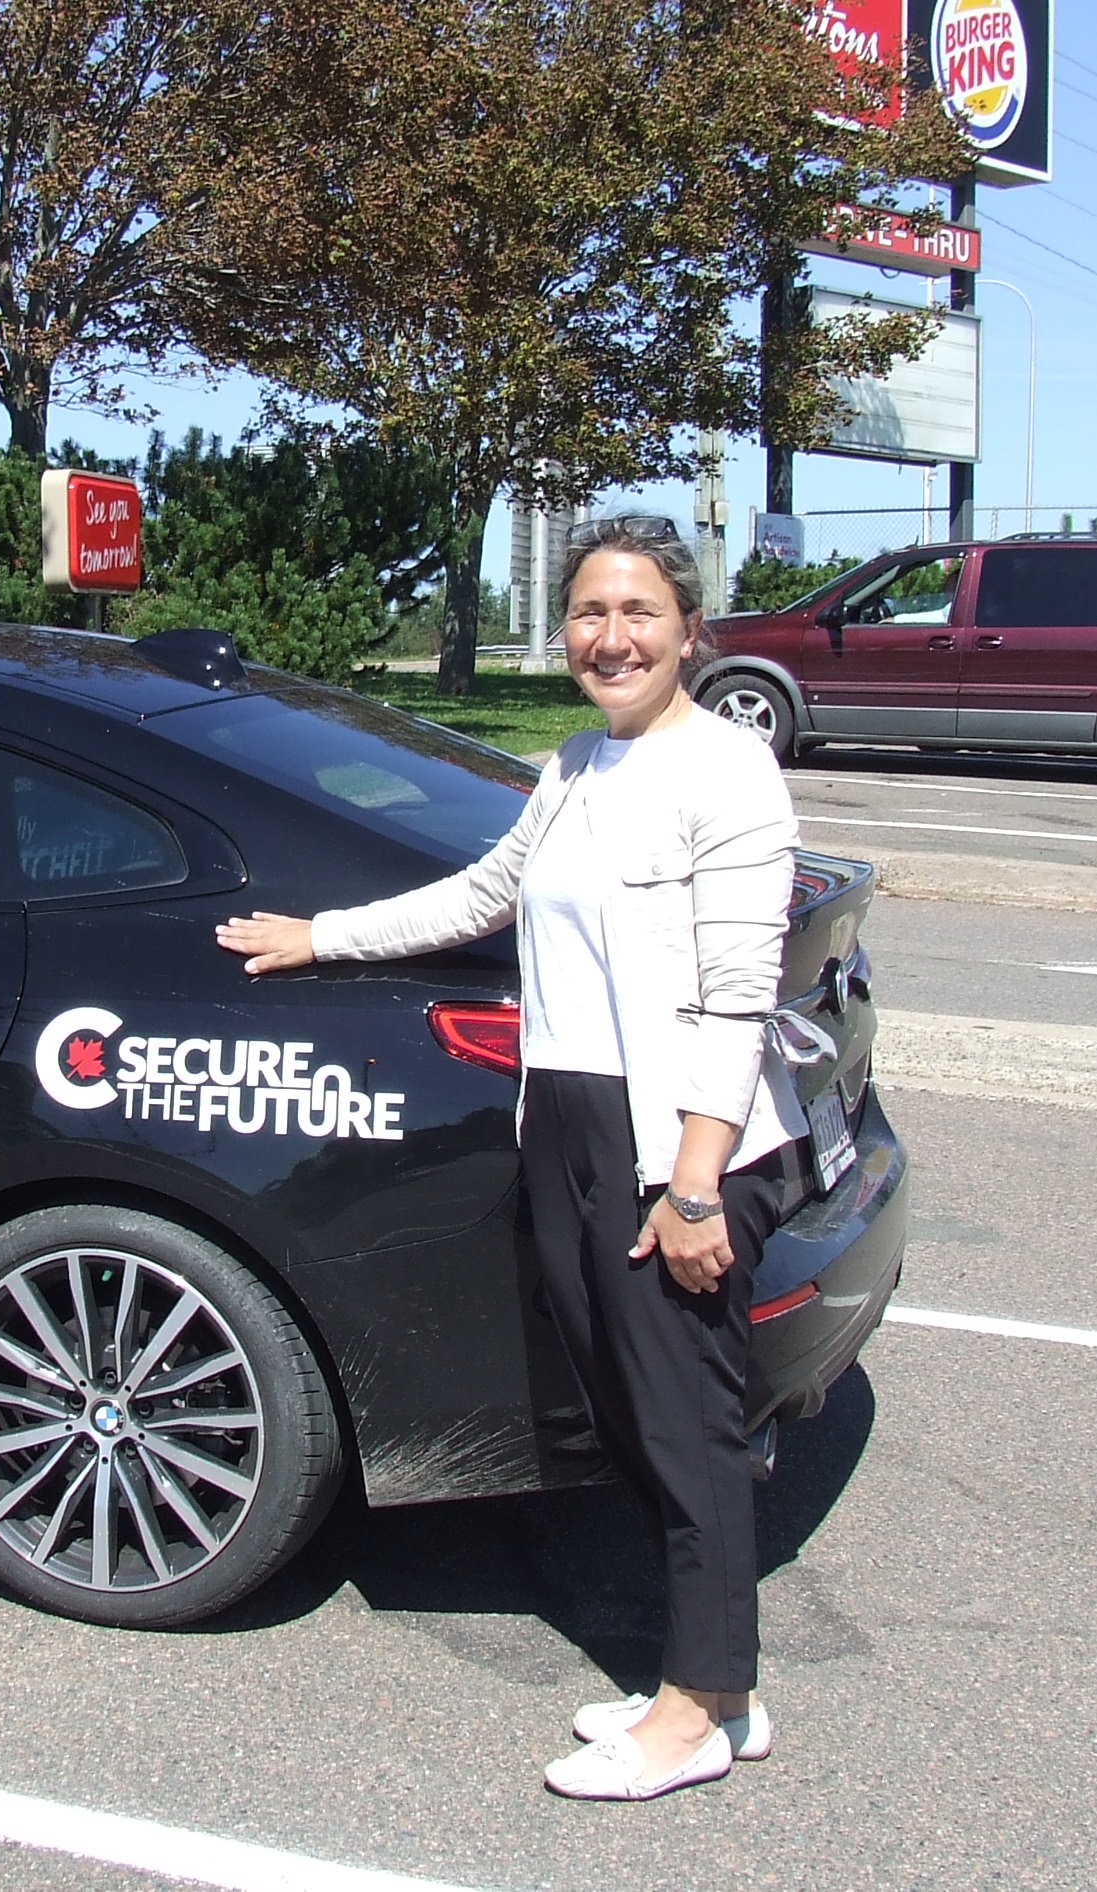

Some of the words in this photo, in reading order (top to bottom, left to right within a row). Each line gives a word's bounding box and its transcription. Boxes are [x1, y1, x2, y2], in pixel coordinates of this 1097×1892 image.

[945, 12, 1012, 54] BURGER
[948, 41, 1015, 97] KING
[86, 490, 107, 525] See
[109, 499, 130, 540] you
[79, 534, 137, 574] tomorrow!
[116, 1036, 315, 1089] SECURE
[117, 1083, 198, 1122] THE
[198, 1064, 405, 1141] FUTURE
